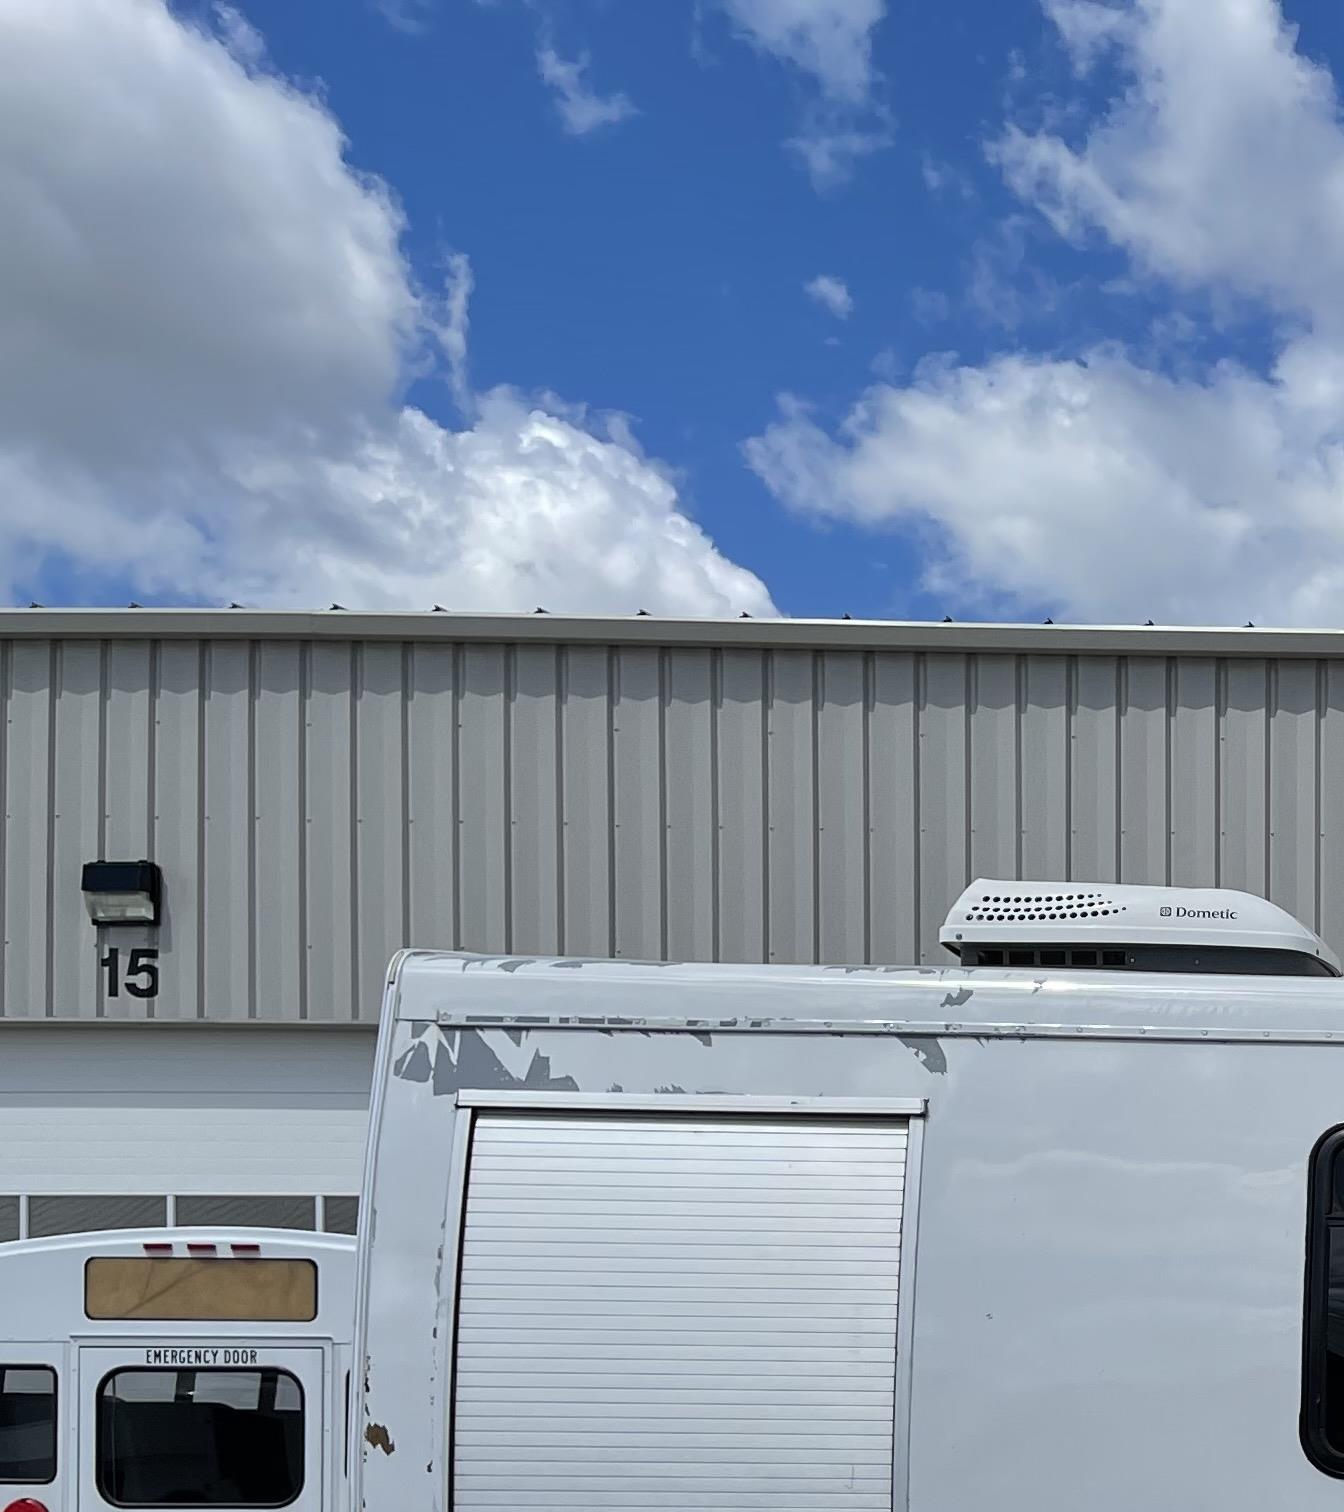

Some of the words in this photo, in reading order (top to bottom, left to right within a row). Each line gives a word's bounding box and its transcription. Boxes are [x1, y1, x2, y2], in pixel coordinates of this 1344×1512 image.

[1176, 906, 1238, 920] Dometic
[101, 948, 158, 998] 15
[146, 1349, 219, 1364] EMERGENCY
[223, 1350, 258, 1364] DOOR
